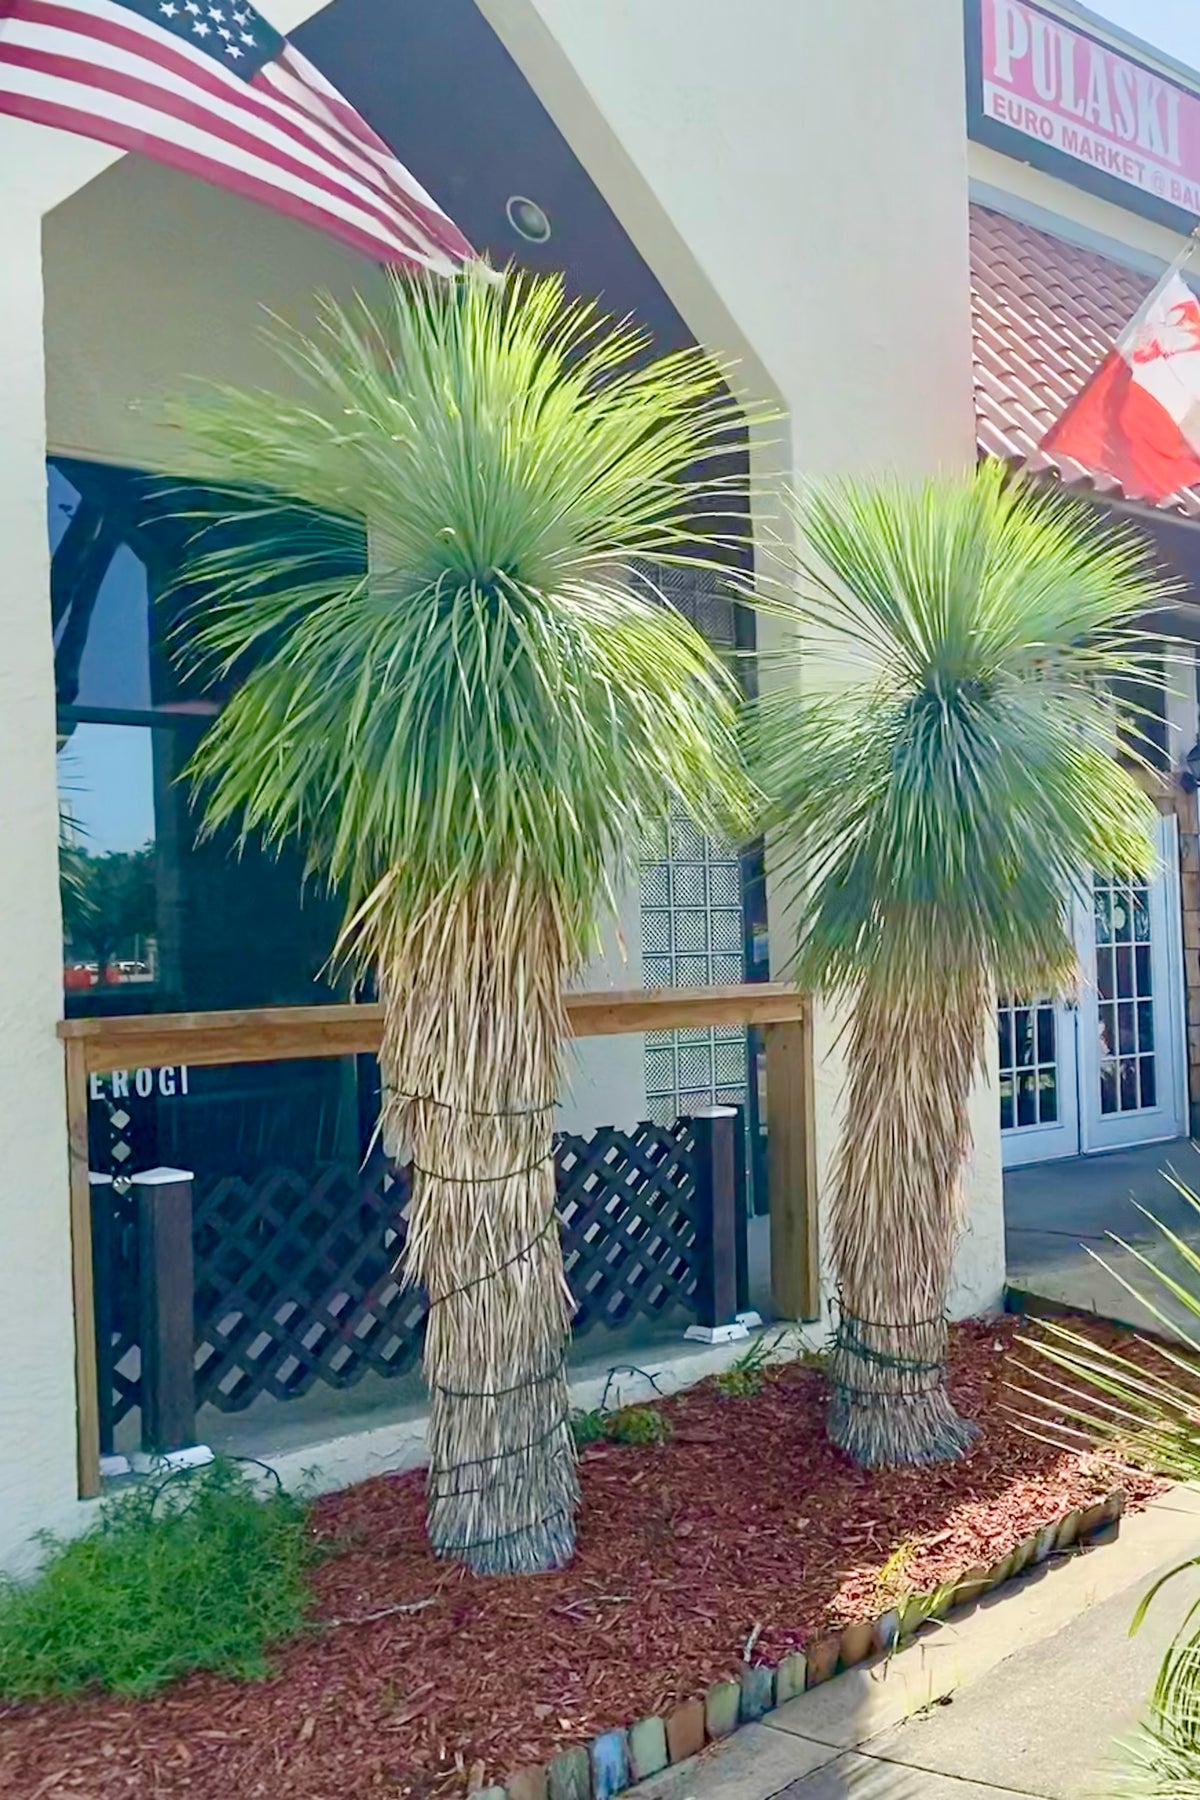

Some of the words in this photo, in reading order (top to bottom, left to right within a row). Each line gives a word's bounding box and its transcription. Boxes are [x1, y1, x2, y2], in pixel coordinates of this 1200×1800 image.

[993, 0, 1181, 166] PULASKI
[993, 93, 1054, 140] EURO
[1062, 126, 1146, 183] MARKET
